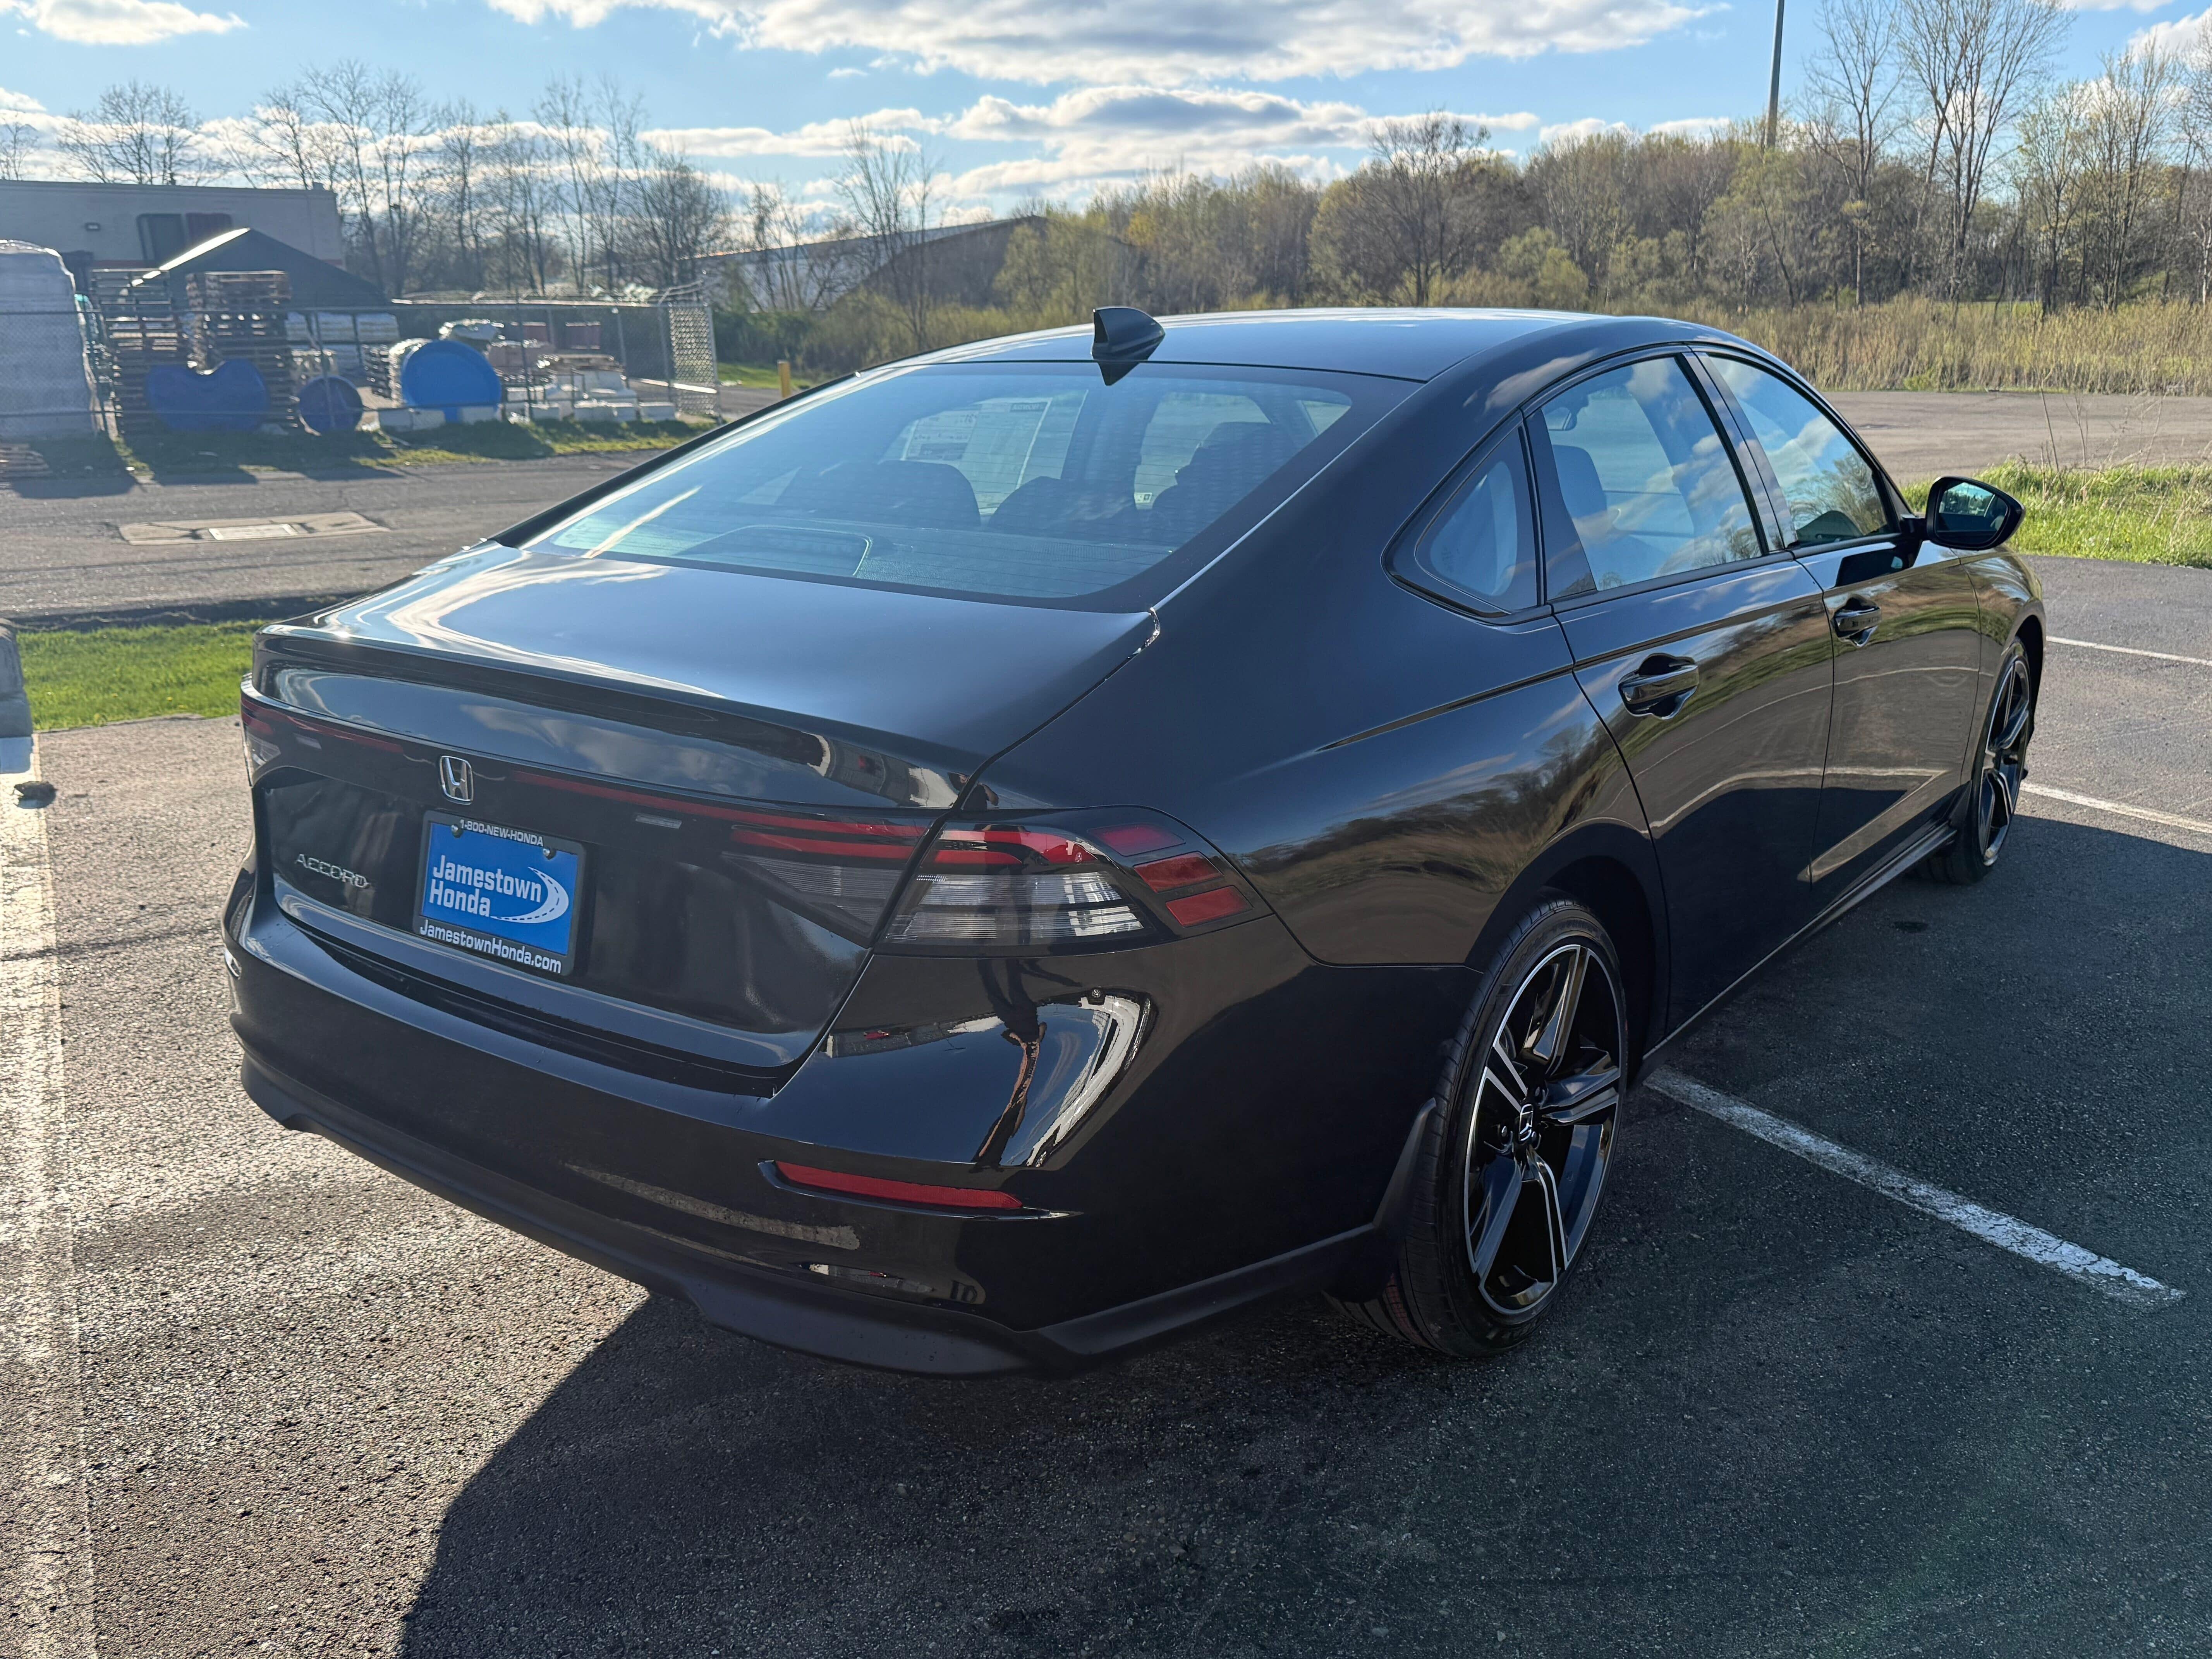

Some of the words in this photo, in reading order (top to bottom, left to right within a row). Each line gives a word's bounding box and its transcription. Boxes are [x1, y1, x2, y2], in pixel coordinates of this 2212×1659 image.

[460, 819, 543, 847] 1-800-NEW-HONDA
[295, 854, 371, 888] ACCORD
[433, 855, 542, 903] Jamestown
[429, 879, 491, 917] Honda
[420, 920, 562, 974] JamestownHonda.com
